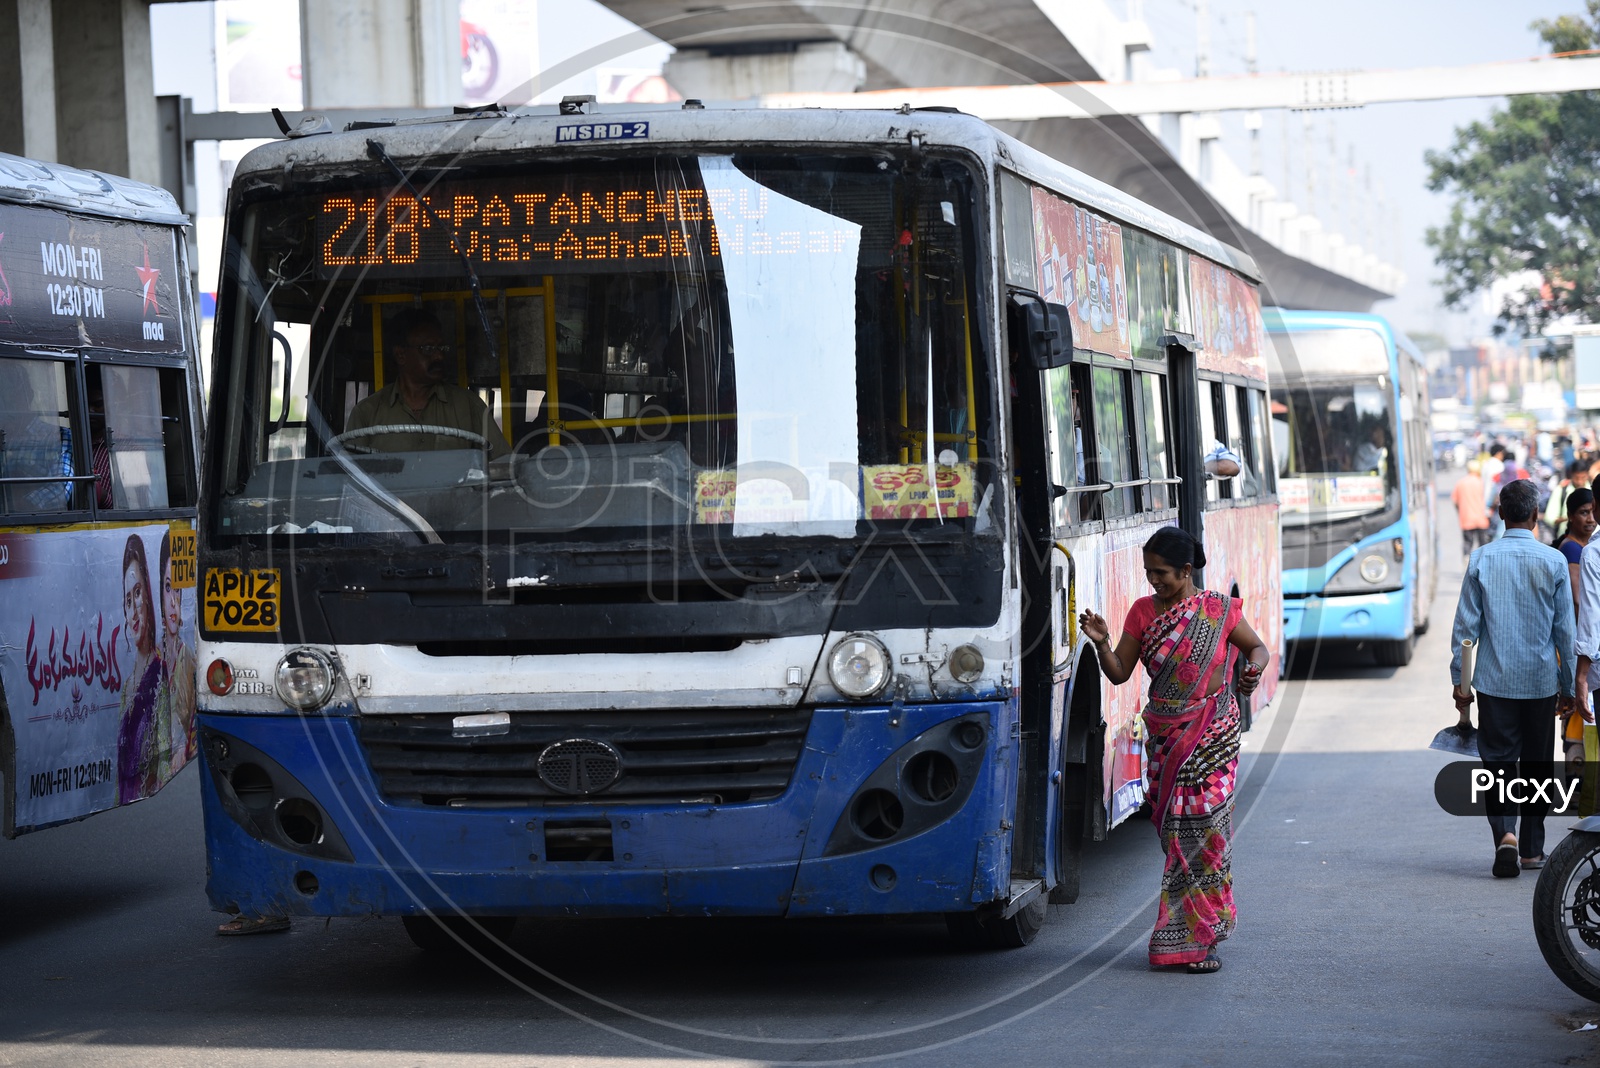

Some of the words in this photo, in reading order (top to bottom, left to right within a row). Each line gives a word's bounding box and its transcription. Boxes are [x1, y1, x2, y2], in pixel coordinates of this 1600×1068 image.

[558, 123, 647, 141] MSRD-2
[41, 242, 103, 281] MON-FRI
[47, 284, 82, 317] 12:30
[84, 287, 105, 318] PM
[142, 321, 164, 341] maa
[871, 502, 968, 519] KOTI
[172, 559, 194, 582] 7074
[207, 573, 276, 599] AP11Z
[207, 600, 277, 626] 7028
[234, 669, 258, 679] TATA
[30, 767, 71, 799] MON-FRI
[73, 761, 97, 789] 12:30
[98, 759, 111, 784] PM
